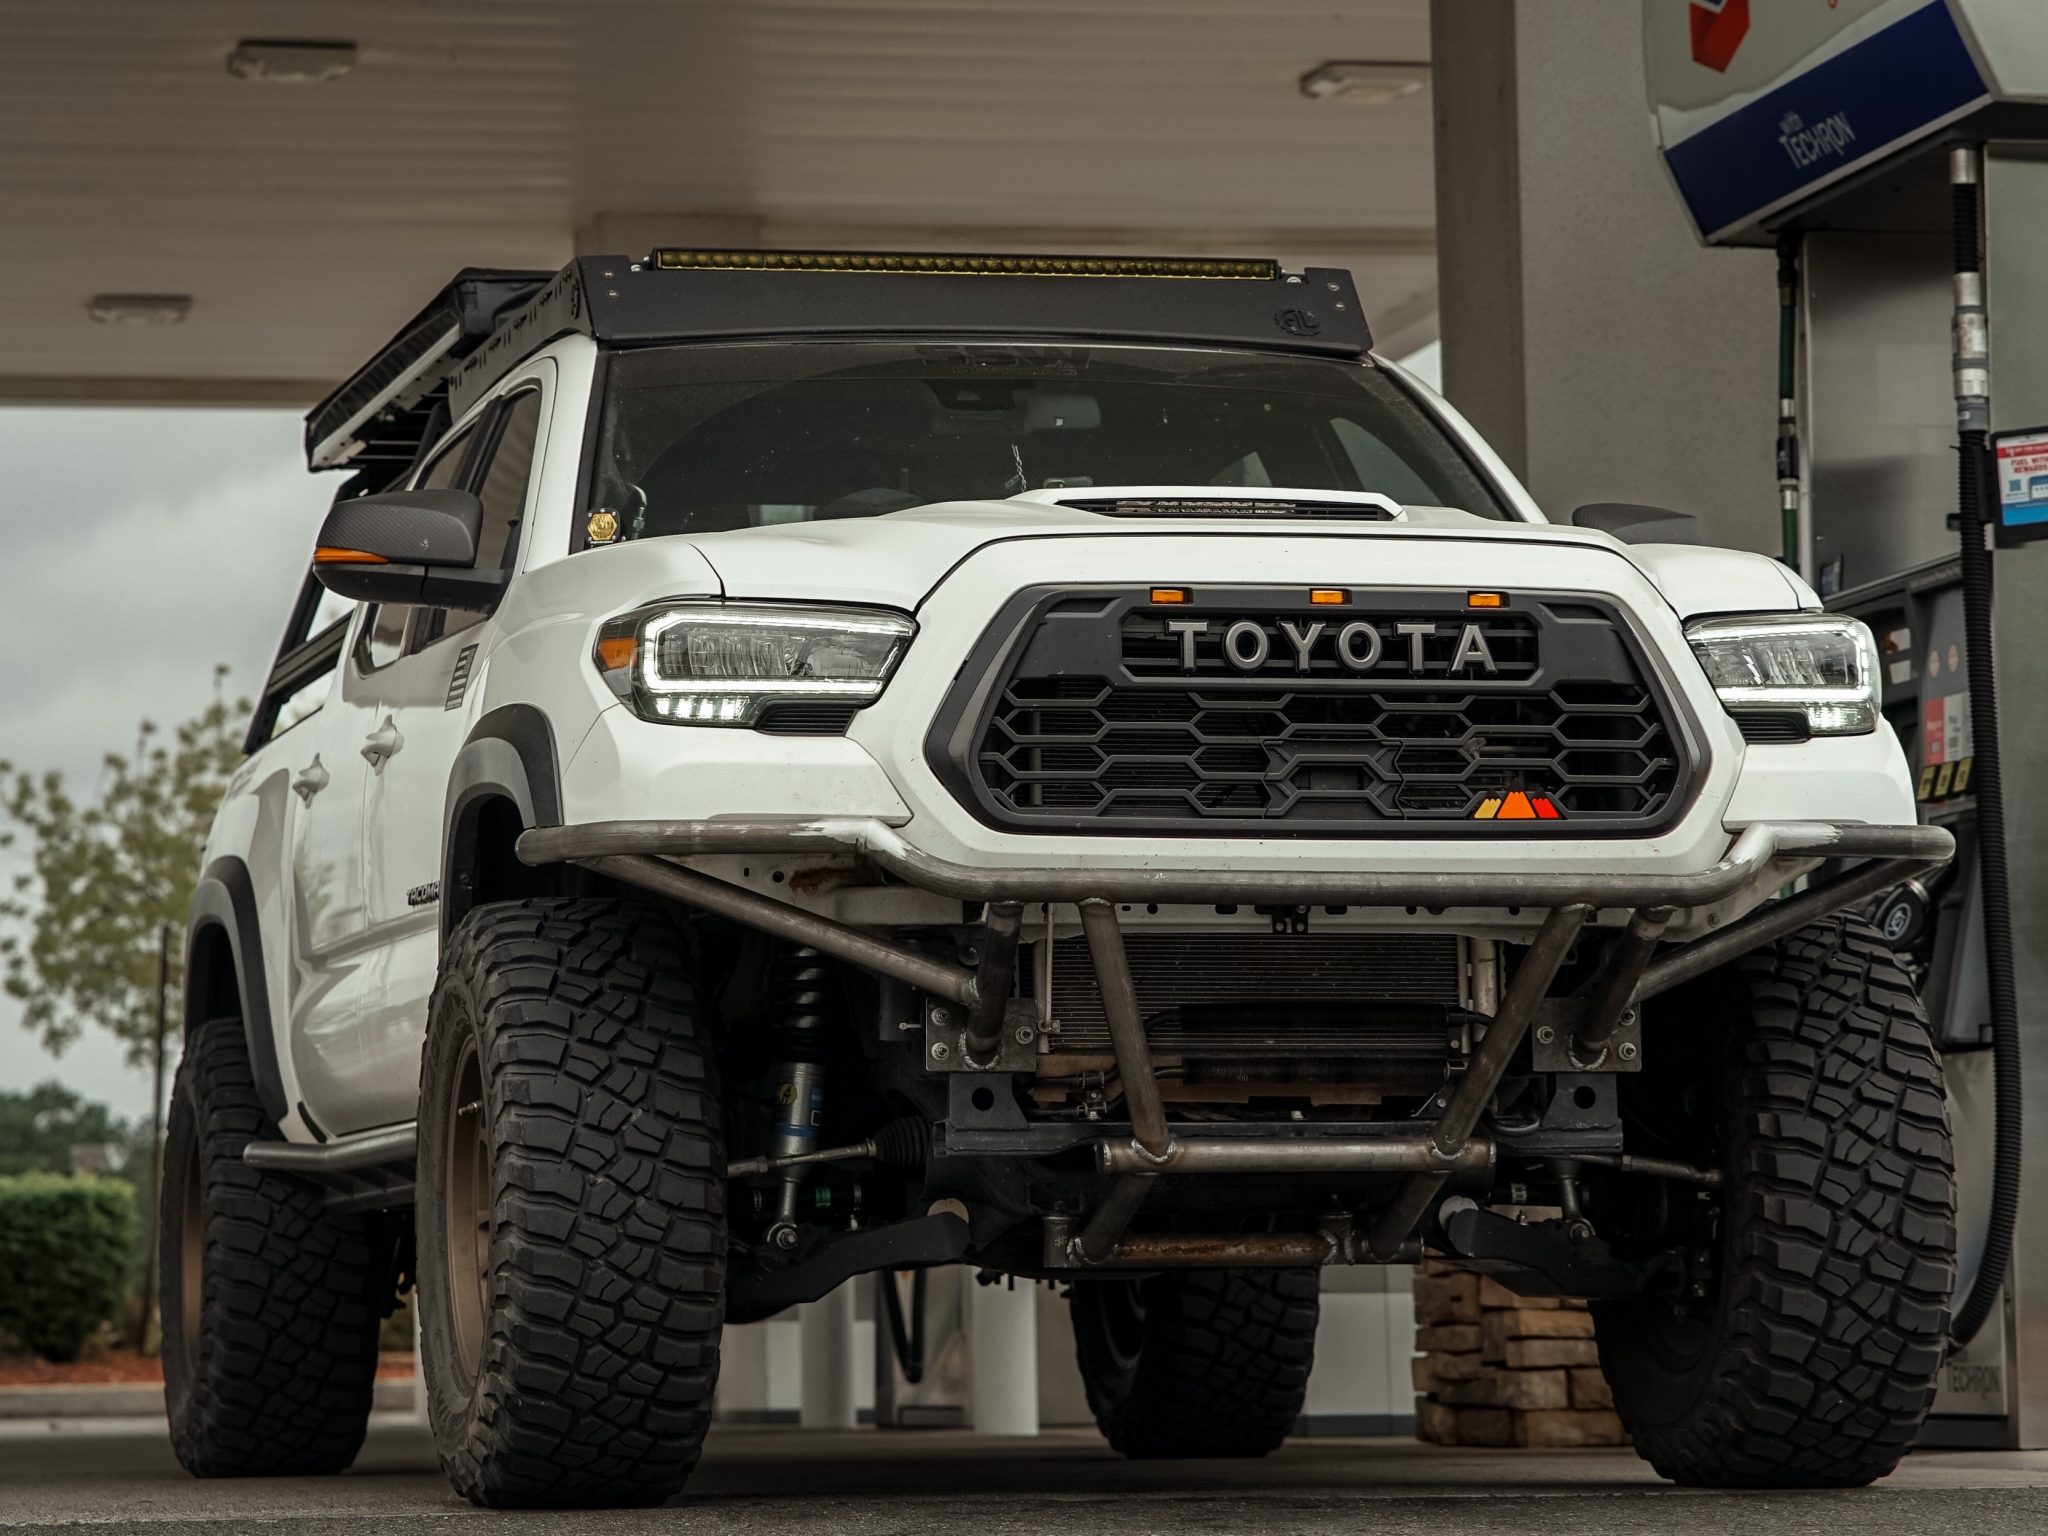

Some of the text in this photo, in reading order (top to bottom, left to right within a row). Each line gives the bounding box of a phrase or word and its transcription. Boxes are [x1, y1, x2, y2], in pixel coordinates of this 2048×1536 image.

[1778, 111, 1857, 169] TECHRON
[1166, 619, 1499, 674] TOYOTA
[406, 880, 441, 908] TACOMA
